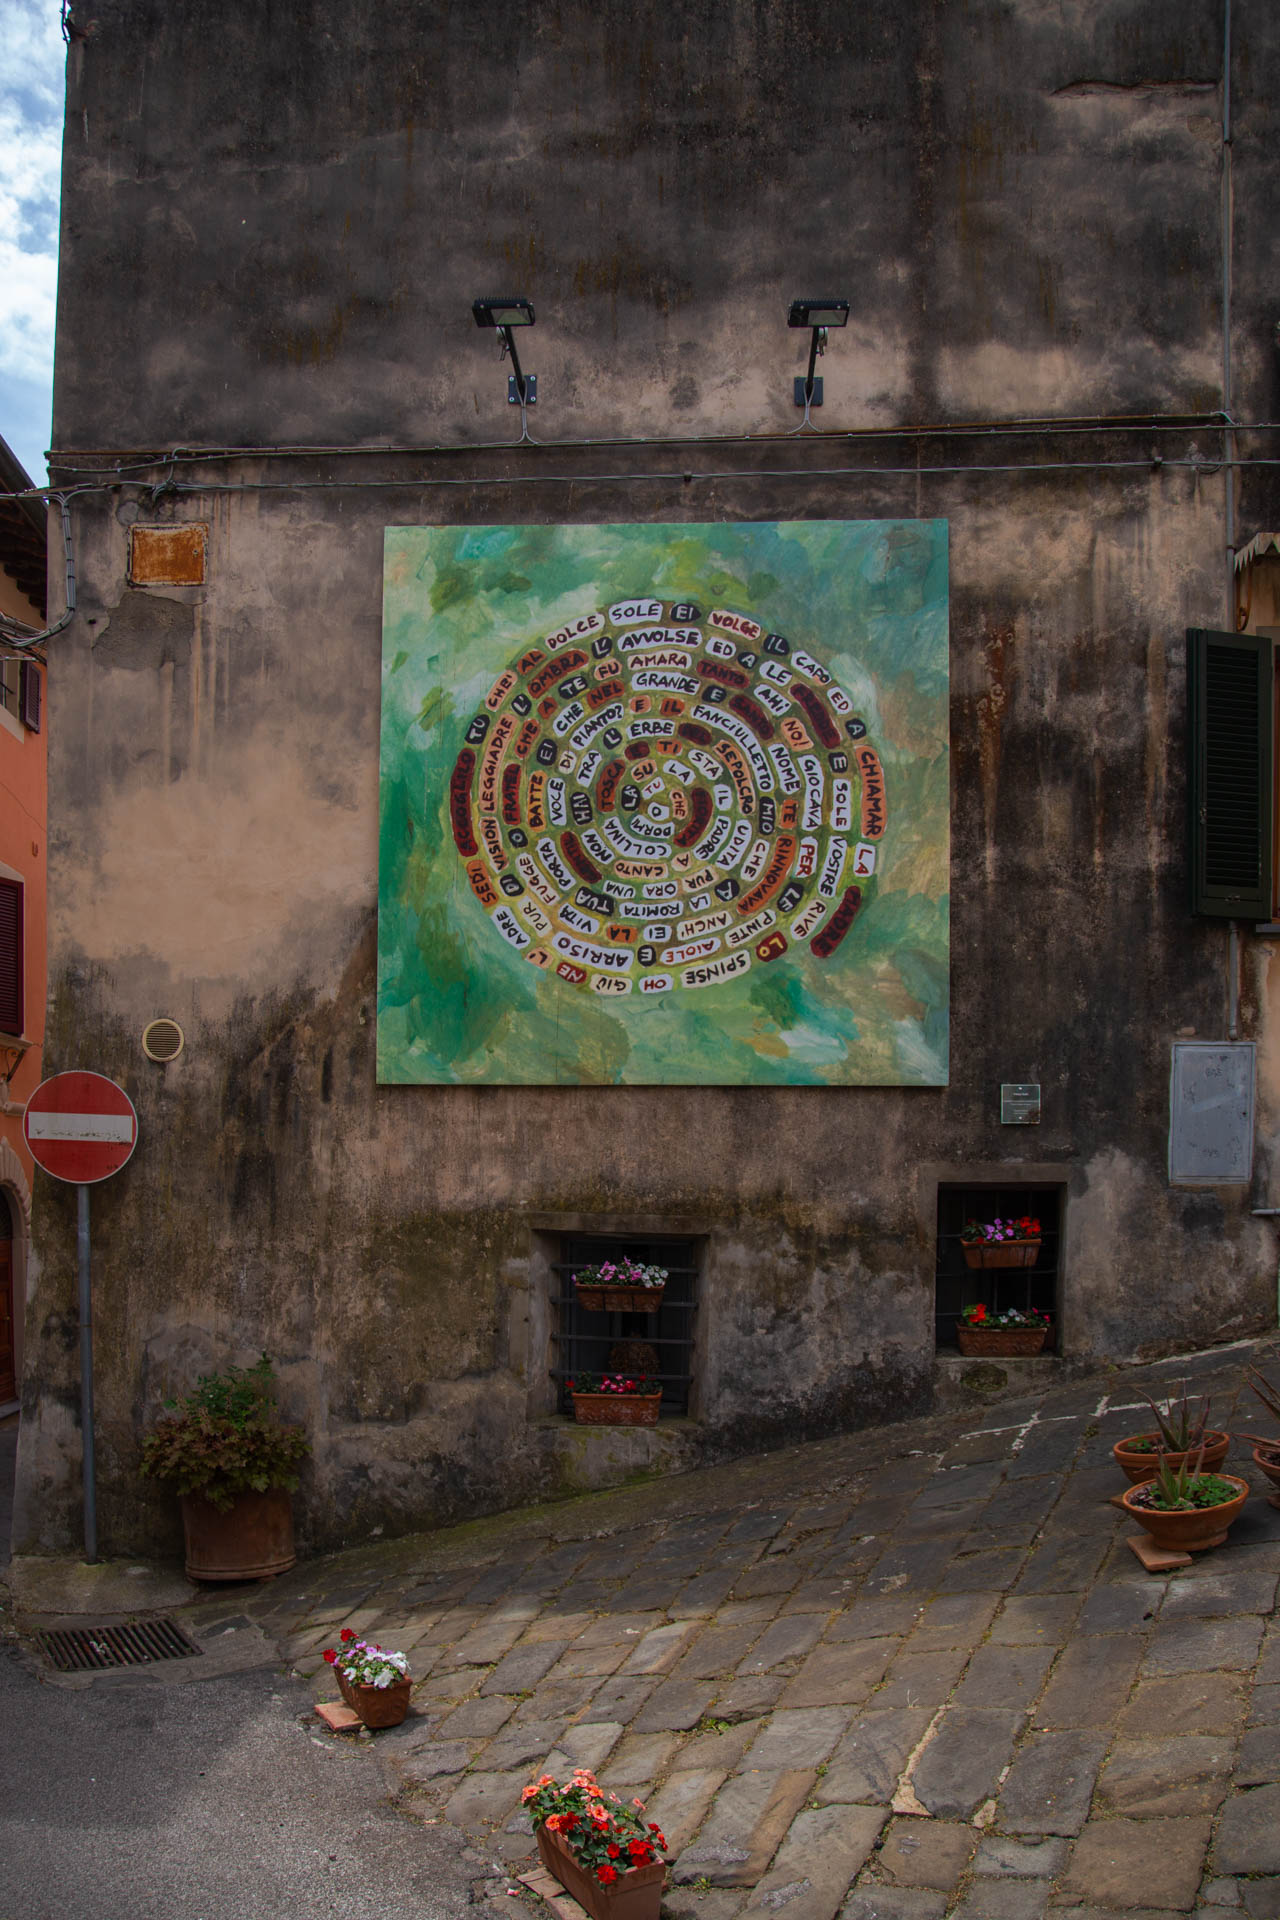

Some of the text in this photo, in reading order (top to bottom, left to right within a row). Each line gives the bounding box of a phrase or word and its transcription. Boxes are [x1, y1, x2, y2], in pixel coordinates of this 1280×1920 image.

[611, 603, 661, 621] SOLE
[676, 606, 694, 619] EI
[547, 615, 600, 650] DOLCE
[712, 612, 760, 639] VOLGE
[621, 630, 700, 651] AVVOLSE
[712, 641, 733, 656] ED
[767, 636, 785, 653] IL
[520, 651, 543, 674] AL
[597, 662, 619, 678] FU
[630, 653, 688, 669] AMARA
[741, 654, 756, 668] A
[796, 656, 830, 684] CAPO
[530, 653, 585, 693] OMBRA
[636, 673, 700, 694] GRANDE
[700, 662, 746, 685] TANTO
[766, 664, 793, 683] LE
[560, 676, 586, 695] TE
[591, 683, 623, 704] NEL
[711, 688, 724, 701] E
[542, 700, 554, 712] A
[663, 700, 681, 709] IL
[830, 691, 849, 711] ED
[556, 703, 584, 731] CHE
[572, 705, 623, 747] PIANTO?
[469, 720, 486, 739] TU
[516, 721, 538, 754] CHE
[630, 721, 674, 737] ERBE
[784, 720, 810, 747] NO!
[849, 724, 864, 735] A
[540, 742, 553, 760] EI
[660, 741, 679, 753] TI
[482, 717, 513, 811] LEGGIADRE
[560, 753, 574, 768] DI
[578, 751, 600, 780] TRA
[633, 762, 654, 780] SU
[692, 752, 720, 778] STA
[771, 746, 800, 792] NOME
[833, 756, 847, 769] E
[668, 764, 691, 783] LA
[716, 743, 753, 815] SEPOLCRO
[503, 766, 521, 823] FRATEL
[601, 763, 624, 808] TOSCA
[644, 781, 661, 794] TU
[804, 759, 822, 829] GIOCAVA
[861, 750, 883, 837] CHIAMAR
[453, 752, 473, 851] ACCOGLILO
[529, 774, 544, 828] BATTE
[550, 779, 564, 821] VOCE
[573, 794, 590, 821] HAI
[672, 791, 686, 817] CHE
[718, 790, 729, 805] IL
[835, 782, 848, 827] SOLE
[652, 806, 662, 817] O
[761, 802, 774, 832] MIO
[783, 802, 798, 823] TE
[512, 832, 523, 843] O
[605, 819, 667, 855] COLLINA
[631, 818, 672, 836] DORMI
[695, 818, 729, 859] PADRE
[484, 819, 506, 871] VISION
[585, 833, 613, 862] NON
[716, 825, 749, 866] UDITA
[540, 841, 572, 887] PORTA
[615, 863, 664, 877] CANTO
[676, 853, 689, 867] A
[744, 842, 766, 877] CHE
[795, 844, 815, 877] PER
[819, 838, 843, 896] VOSTRE
[854, 848, 873, 875] LA
[519, 857, 557, 904] FUGGE
[684, 868, 714, 889] PUR
[741, 836, 793, 912] RINNOVAVA
[471, 868, 497, 904] SEDI
[502, 879, 520, 894] DI
[605, 882, 635, 898] UNA
[645, 883, 677, 896] ORA
[716, 881, 733, 900] A
[576, 889, 610, 913] TUA
[624, 902, 681, 916] ROMITA
[690, 895, 709, 910] LA
[778, 888, 801, 912] LE
[496, 910, 528, 945] ADRE
[522, 902, 548, 932] PUR
[560, 905, 592, 933] VITA
[728, 911, 774, 943] PINTE
[794, 901, 826, 938] RIVE
[815, 887, 861, 955] MADRE
[610, 927, 631, 940] LA
[648, 927, 666, 939] EI
[557, 936, 629, 968] ARRISO
[641, 949, 653, 960] E
[759, 937, 784, 957] LO
[558, 964, 583, 981] NE
[685, 953, 747, 985] SPINSE
[643, 979, 667, 991] OH
